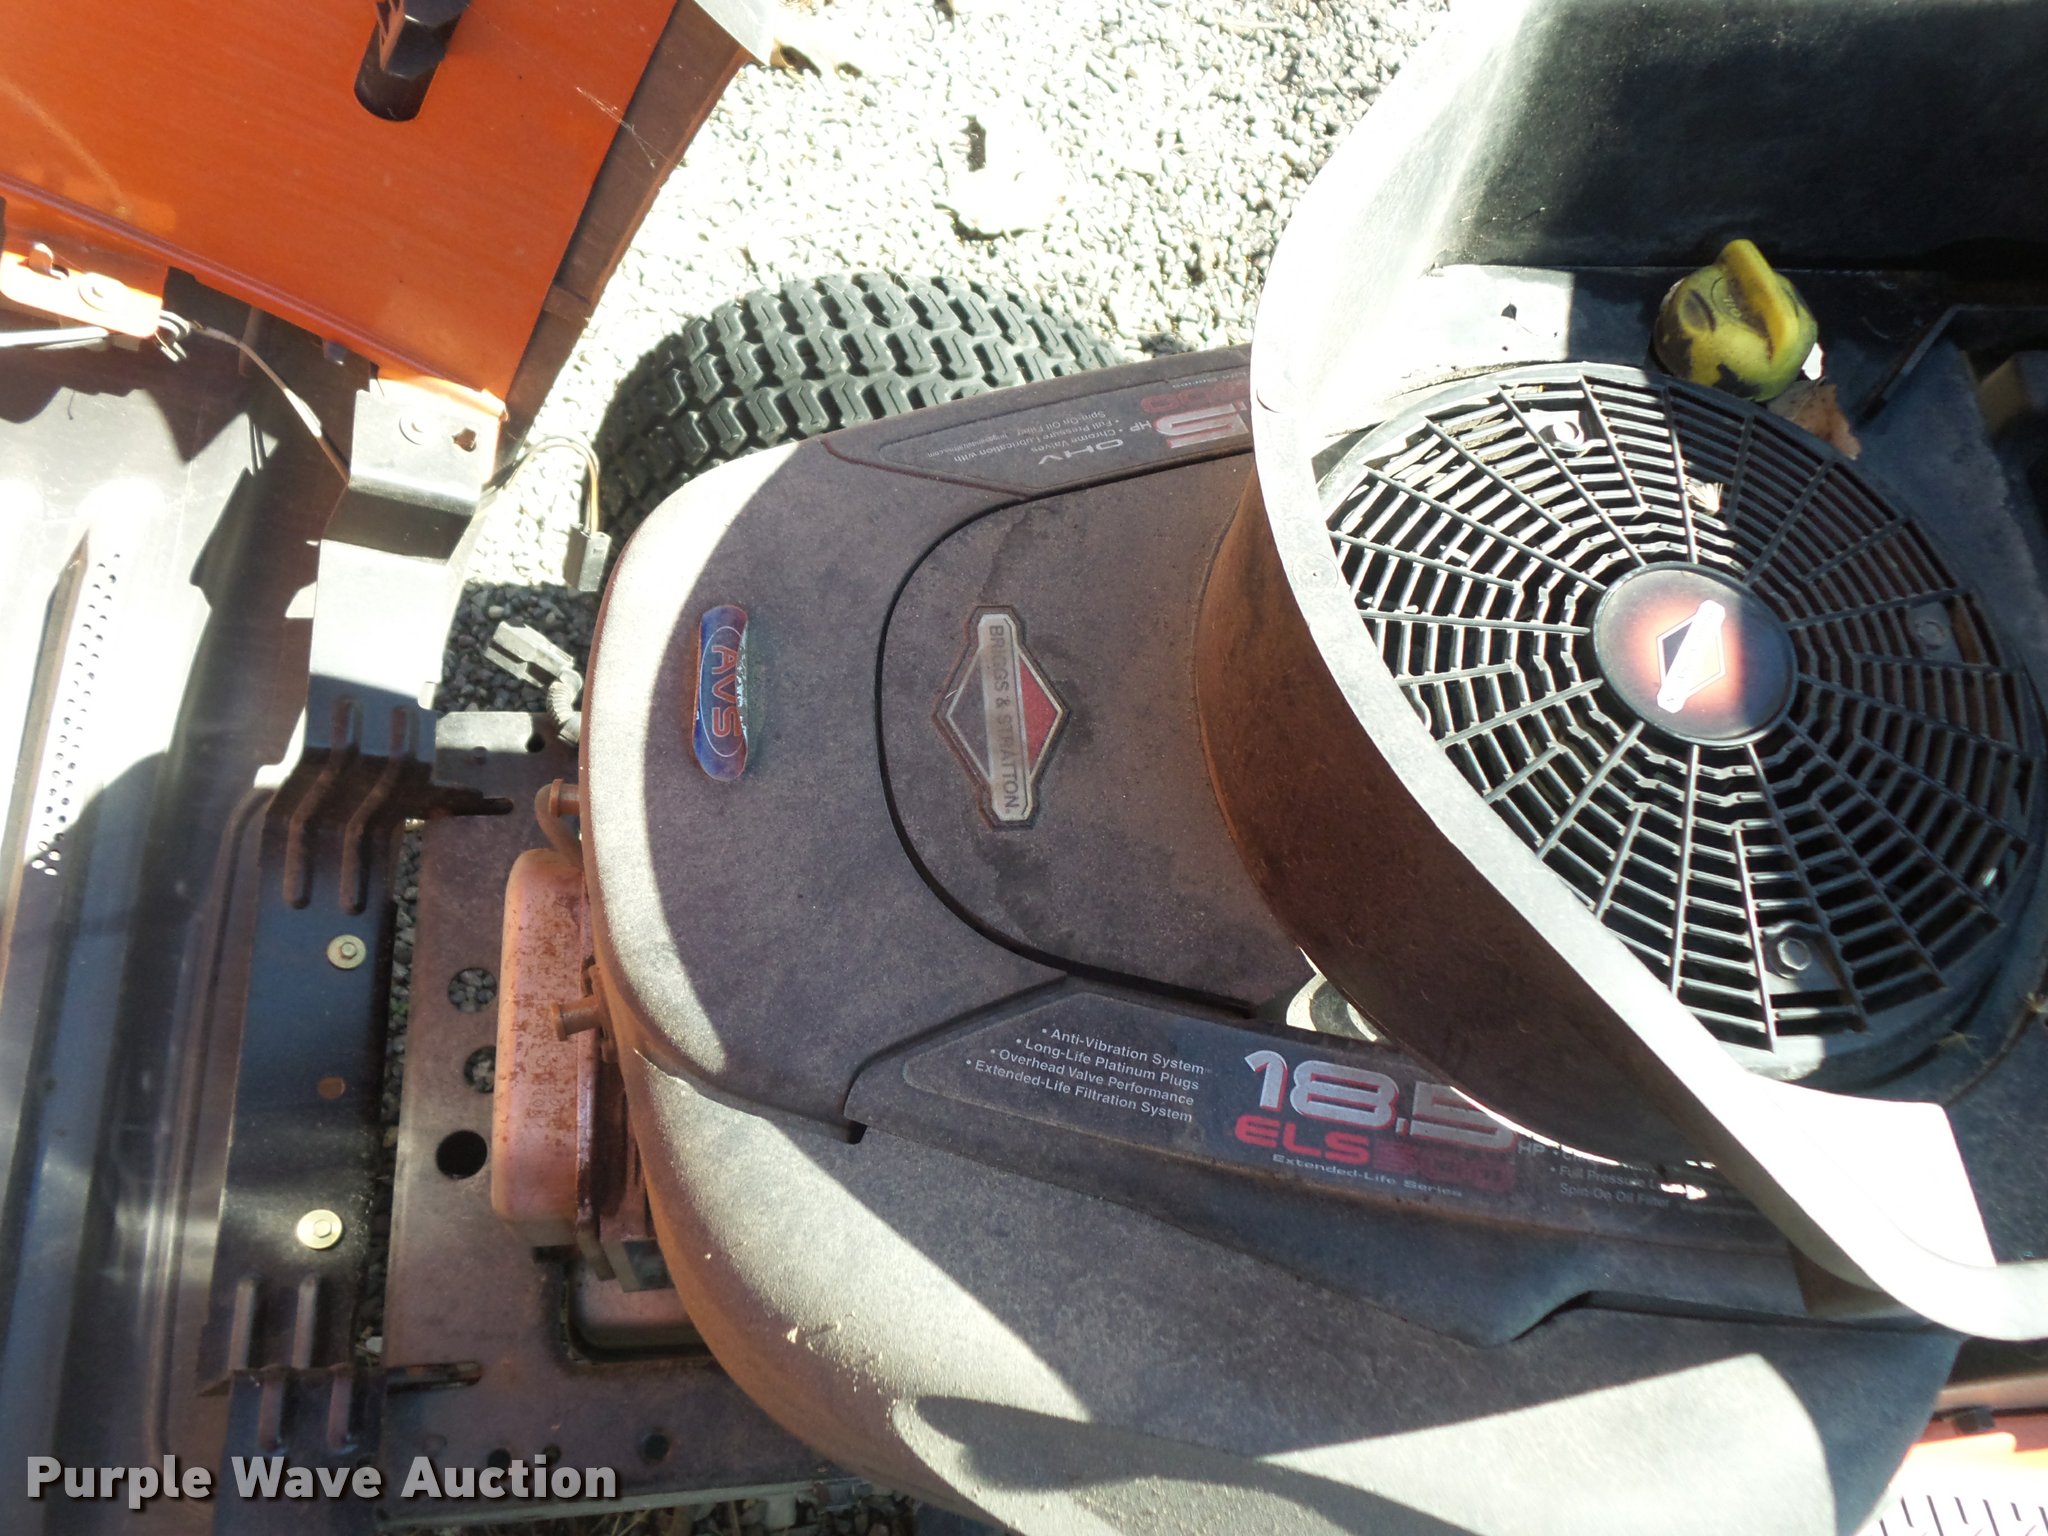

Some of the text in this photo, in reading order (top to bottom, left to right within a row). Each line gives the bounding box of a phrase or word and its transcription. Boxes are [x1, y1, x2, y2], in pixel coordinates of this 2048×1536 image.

[953, 419, 1113, 463] Full Pressure Lubrication with
[1030, 429, 1117, 453] Chrome Valves
[1038, 438, 1125, 465] OHV
[1129, 420, 1152, 433] HP
[988, 624, 1011, 698] BRIGGS
[711, 644, 742, 738] AVS
[996, 711, 1020, 809] STRATTON
[1025, 1038, 1200, 1092] Long-Life Platinum Plugs
[1050, 1028, 1148, 1062] Anti-Vibration
[975, 1059, 1193, 1123] Extended-Life Filtration System
[999, 1048, 1194, 1106] Overhead Valve Performance
[1243, 1049, 1517, 1153] 18.5
[1271, 1152, 1463, 1198] Extended-Life Series
